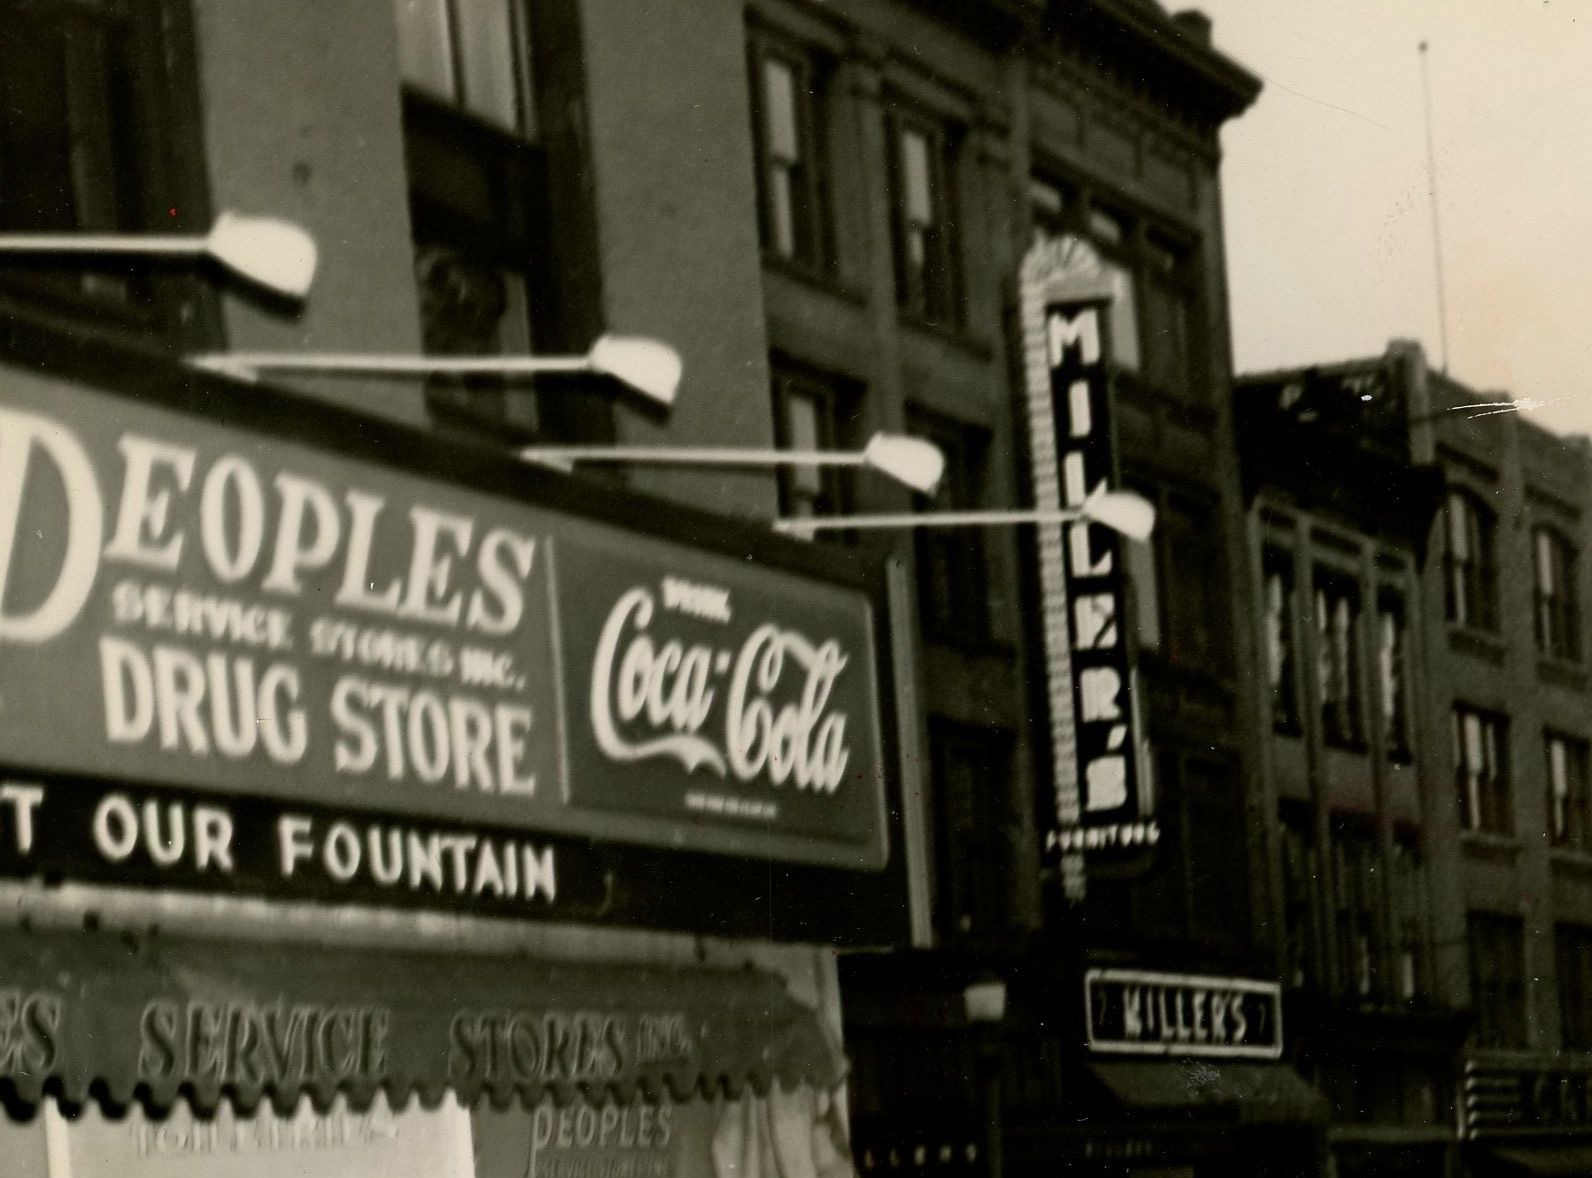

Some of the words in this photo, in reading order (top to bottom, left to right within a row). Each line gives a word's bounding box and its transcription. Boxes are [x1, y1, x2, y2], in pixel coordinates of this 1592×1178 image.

[98, 634, 308, 763] DRUG
[330, 675, 537, 795] STORE
[590, 587, 849, 792] Coca-Cola
[93, 793, 236, 871] OUR
[277, 815, 558, 902] FOUNTAIN
[137, 995, 391, 1082] SERVICE
[449, 1009, 626, 1080] STORES
